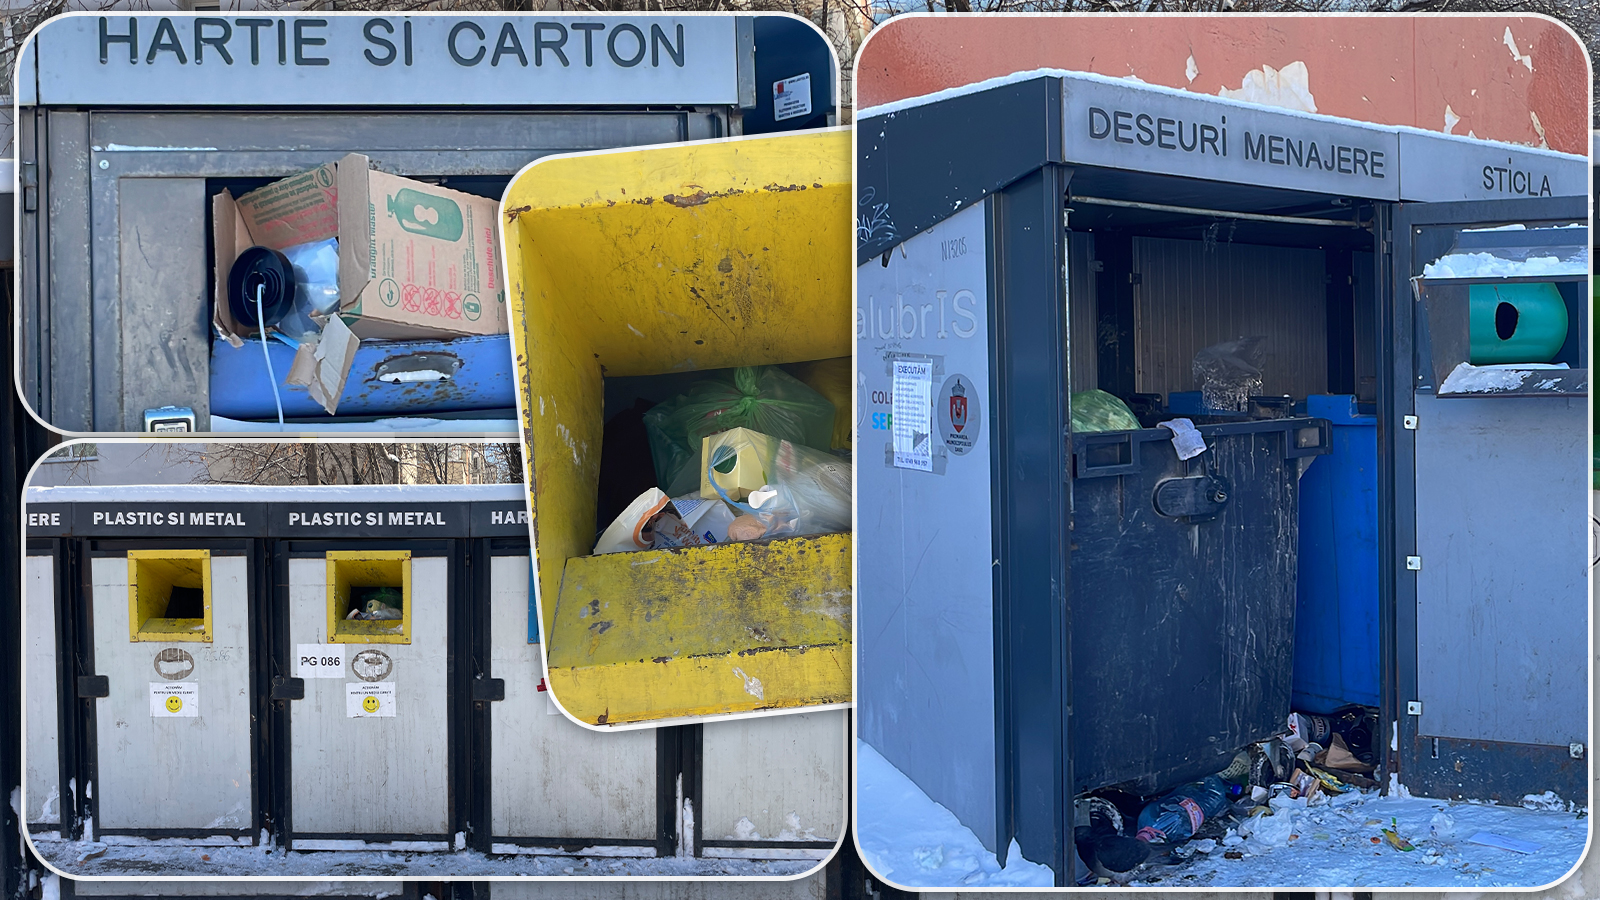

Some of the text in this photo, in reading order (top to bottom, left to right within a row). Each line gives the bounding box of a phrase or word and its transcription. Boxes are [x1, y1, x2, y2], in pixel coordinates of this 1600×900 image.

[99, 16, 330, 66] HARTIE
[447, 21, 685, 68] CARTON
[1243, 130, 1386, 179] MENAJERE
[484, 227, 495, 290] Deschide aici
[93, 512, 246, 526] PLASTIC SI METAL
[288, 511, 446, 526] PLASTIC SI METAL
[301, 656, 340, 667] PG 086
